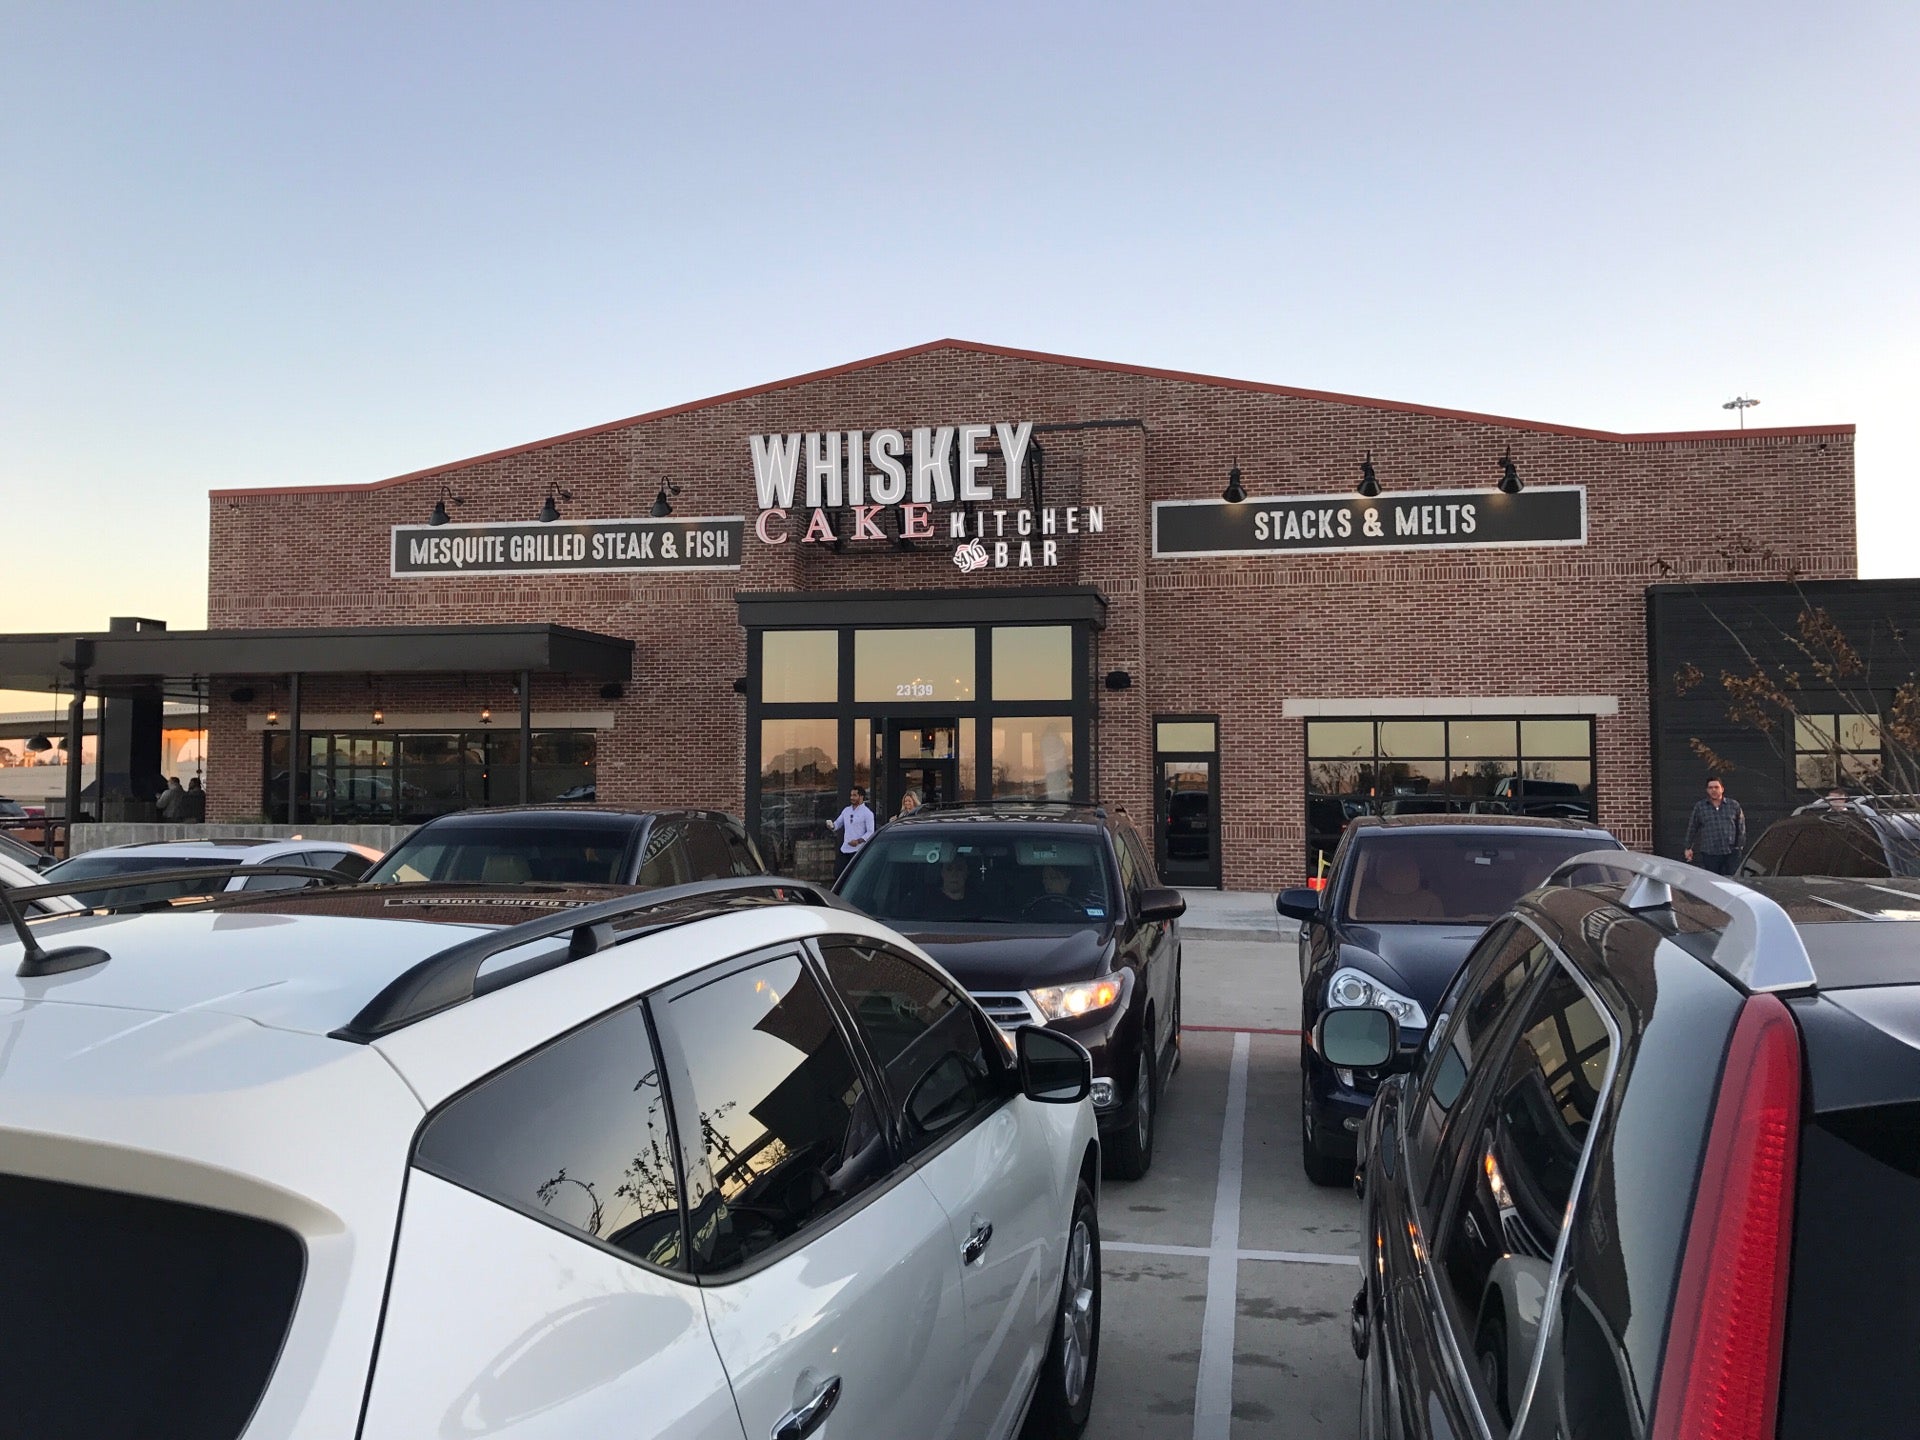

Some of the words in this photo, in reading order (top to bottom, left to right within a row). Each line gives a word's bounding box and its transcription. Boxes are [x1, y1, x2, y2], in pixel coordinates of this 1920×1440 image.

[750, 421, 1034, 509] WHISKEY
[755, 503, 935, 544] CAKE
[950, 506, 1104, 538] KITCHEN
[1254, 508, 1352, 541] STACKS
[1362, 507, 1385, 537] &
[1395, 504, 1476, 536] MELTS
[410, 536, 505, 568] MESQUITE
[510, 533, 586, 562] GRILLED
[592, 531, 655, 560] STEAK
[661, 531, 679, 558] &
[685, 530, 730, 558] FISH
[994, 540, 1058, 568] BAR
[896, 684, 933, 696] 23139
